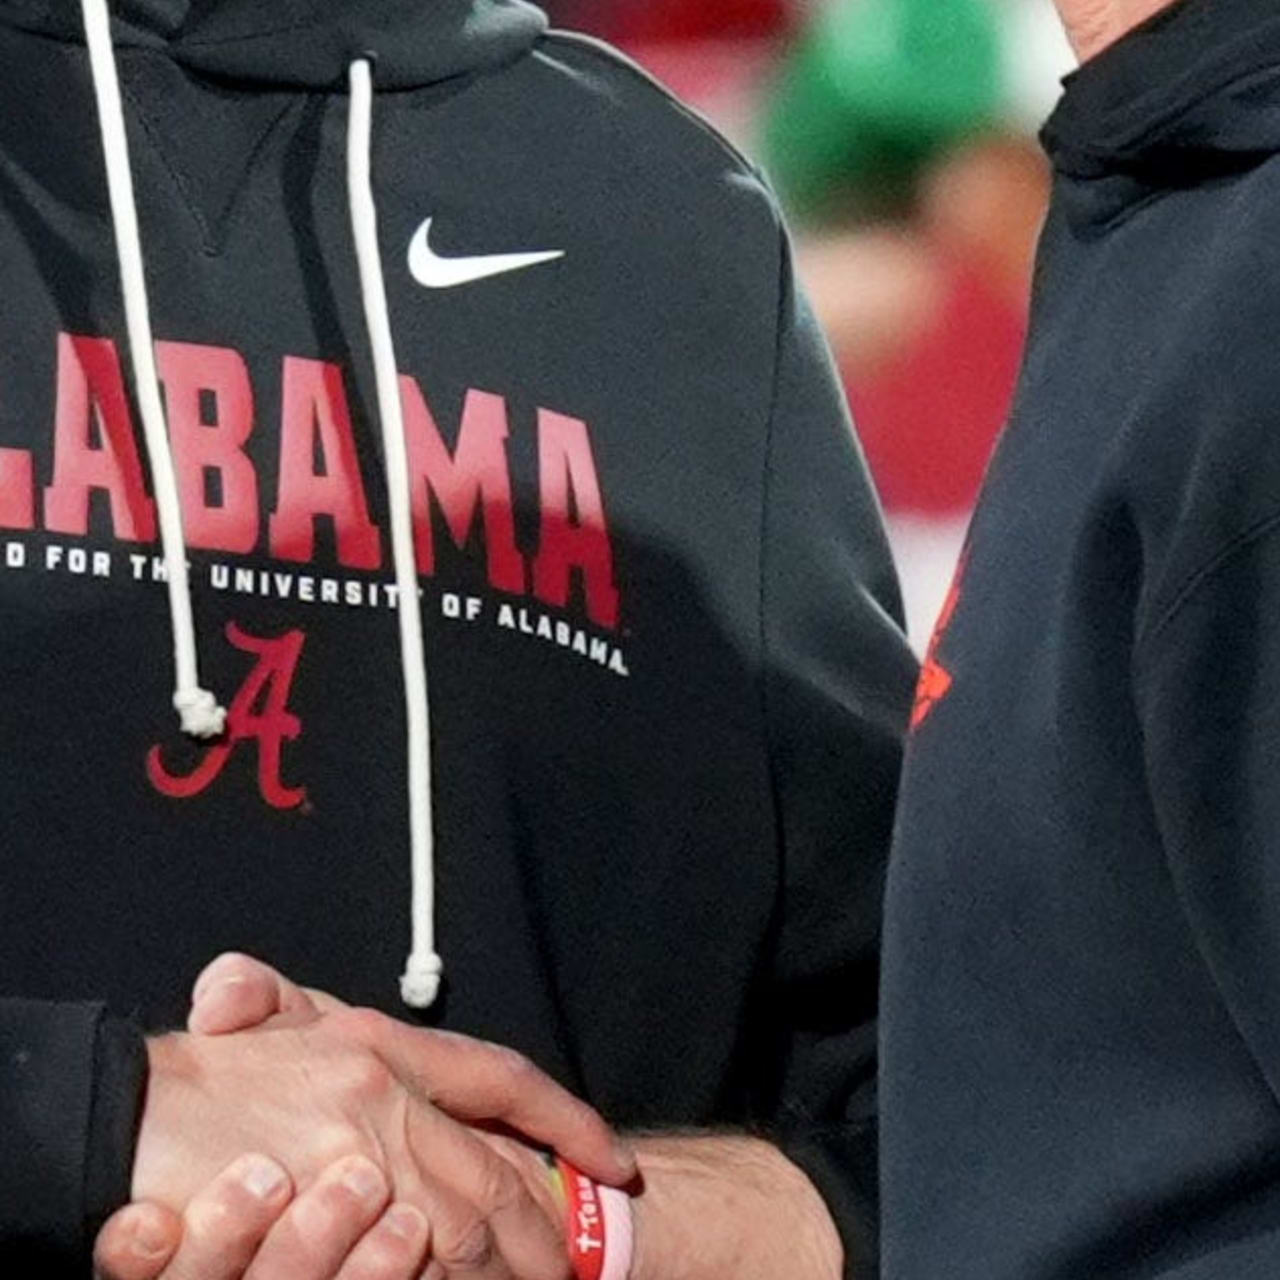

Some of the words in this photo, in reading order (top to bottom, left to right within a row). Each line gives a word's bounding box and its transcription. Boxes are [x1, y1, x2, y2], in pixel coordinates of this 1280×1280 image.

[46, 545, 111, 577] FOR
[211, 565, 424, 609] UNIVERSIT
[442, 593, 481, 620] OF
[497, 603, 627, 675] ALABAMA
[147, 622, 306, 808] A
